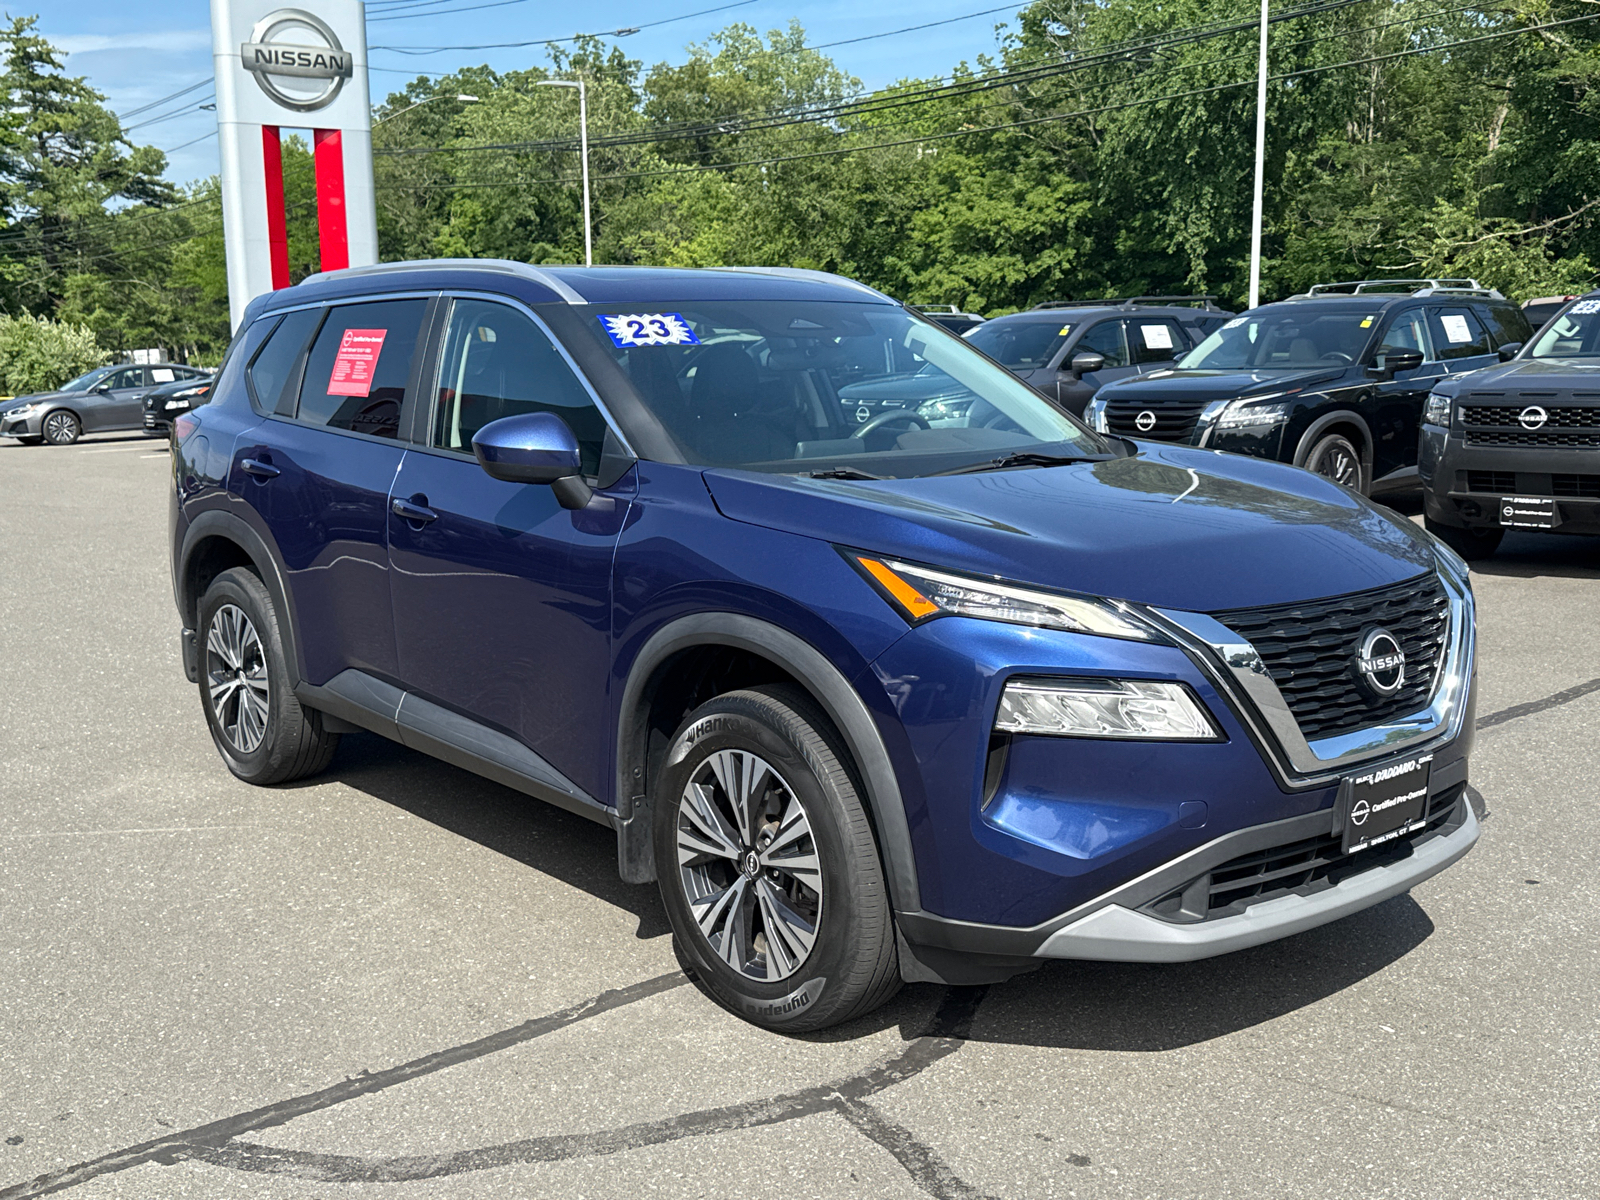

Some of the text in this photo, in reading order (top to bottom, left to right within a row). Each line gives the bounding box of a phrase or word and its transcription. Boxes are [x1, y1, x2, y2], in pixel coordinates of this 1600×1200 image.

[254, 48, 344, 70] NISSAN
[626, 319, 671, 339] 23
[1361, 652, 1405, 672] NISSAN
[1374, 760, 1416, 783] D'ADDARIO
[1372, 786, 1428, 813] Certified Pre-Owned
[1398, 827, 1408, 836] CT
[745, 990, 811, 1017] Dynapro
